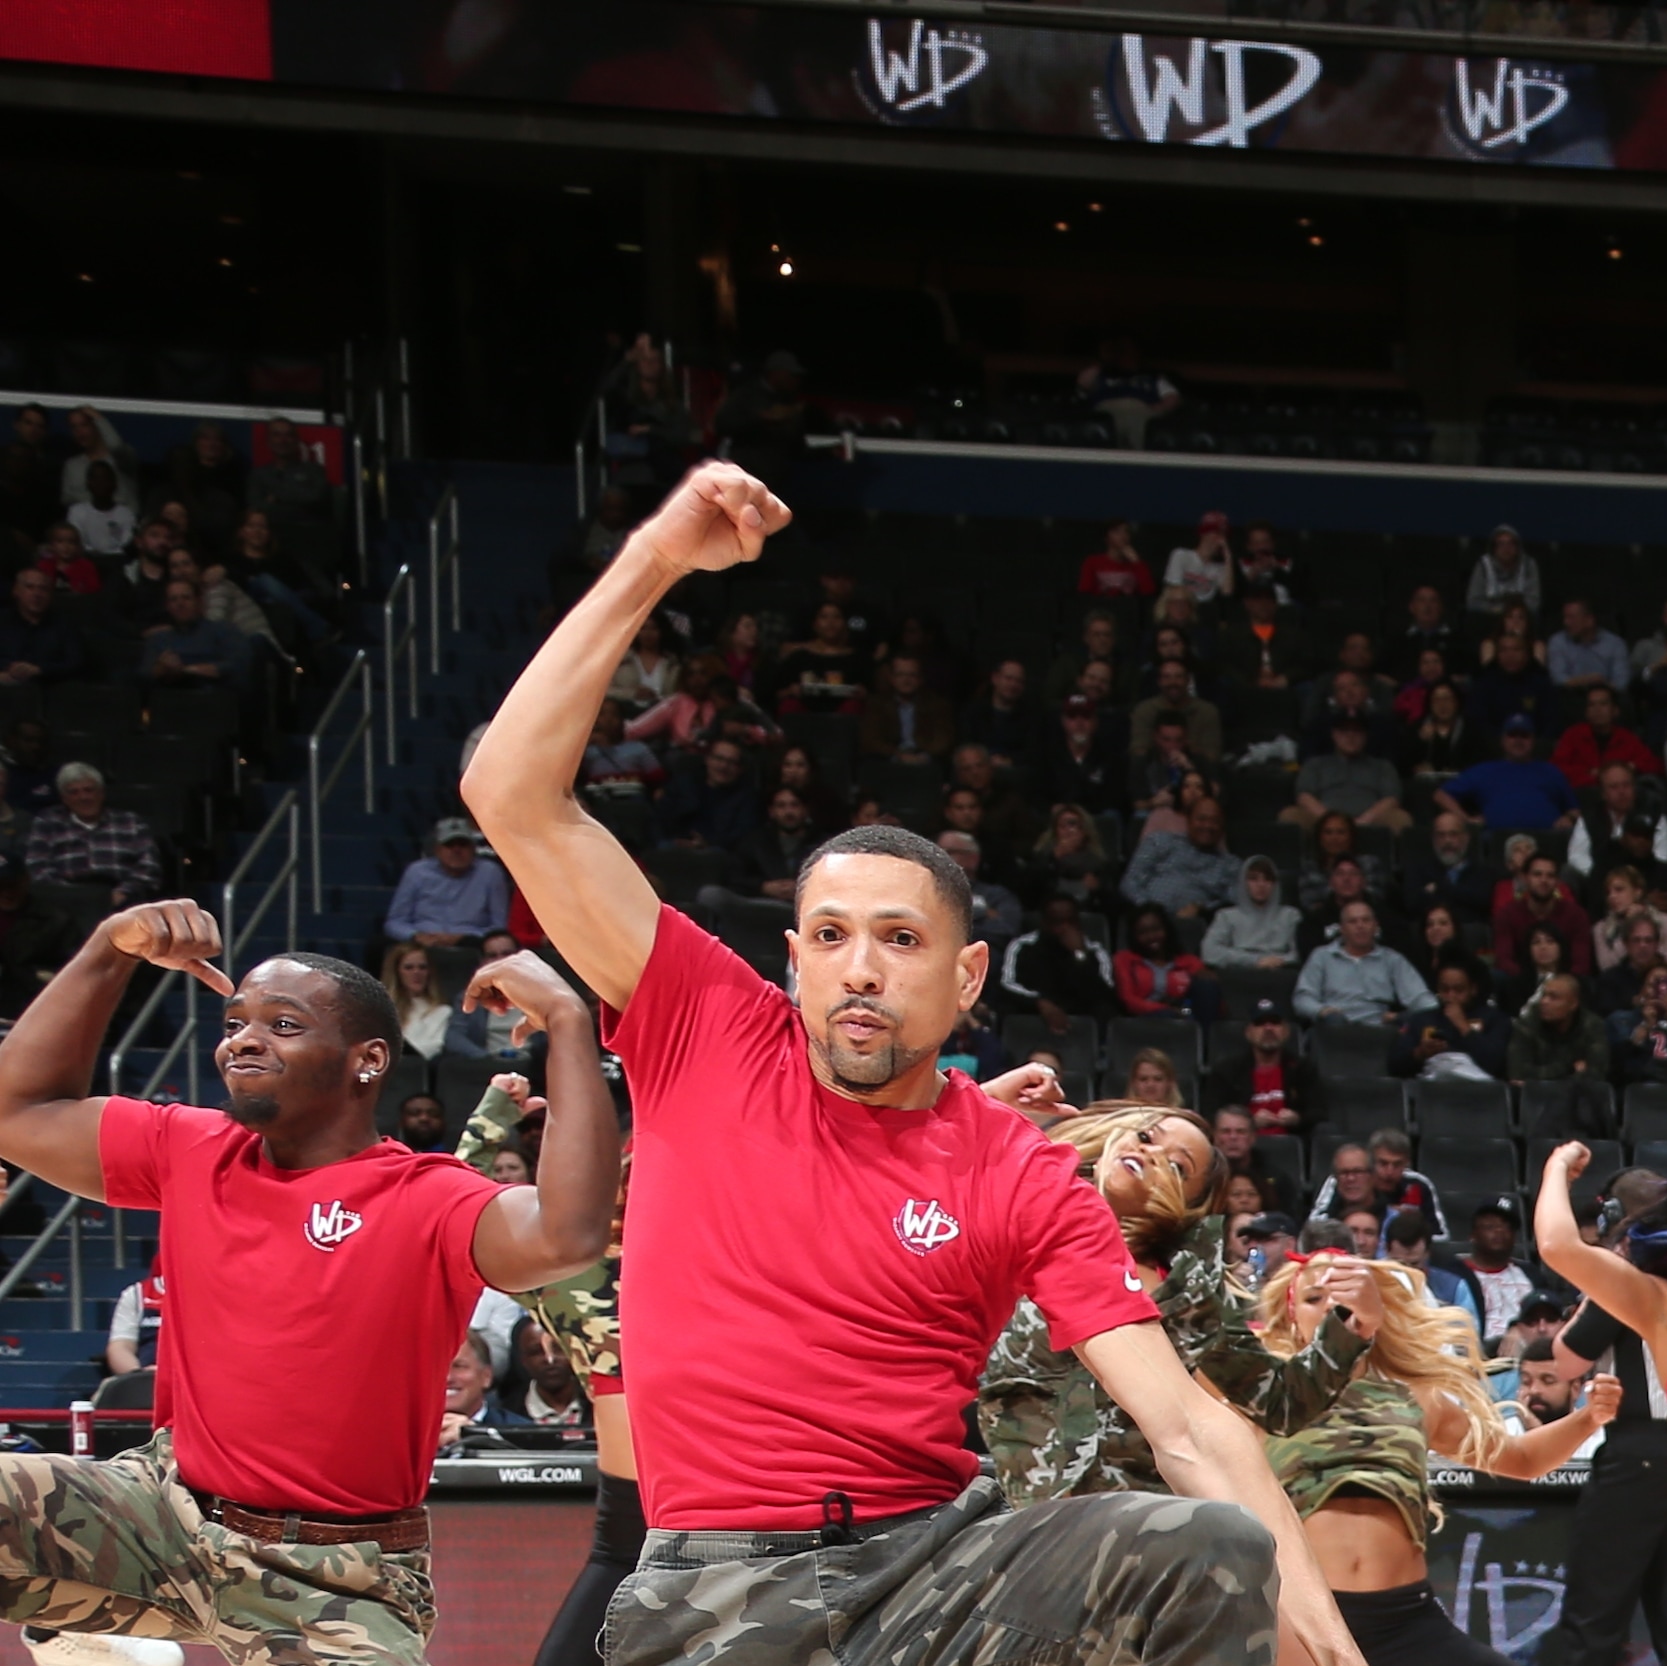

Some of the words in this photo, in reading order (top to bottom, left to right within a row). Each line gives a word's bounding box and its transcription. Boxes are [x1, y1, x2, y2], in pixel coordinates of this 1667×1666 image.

[312, 1200, 363, 1243] WD
[903, 1198, 960, 1249] WD
[498, 1467, 582, 1483] WGL.COM
